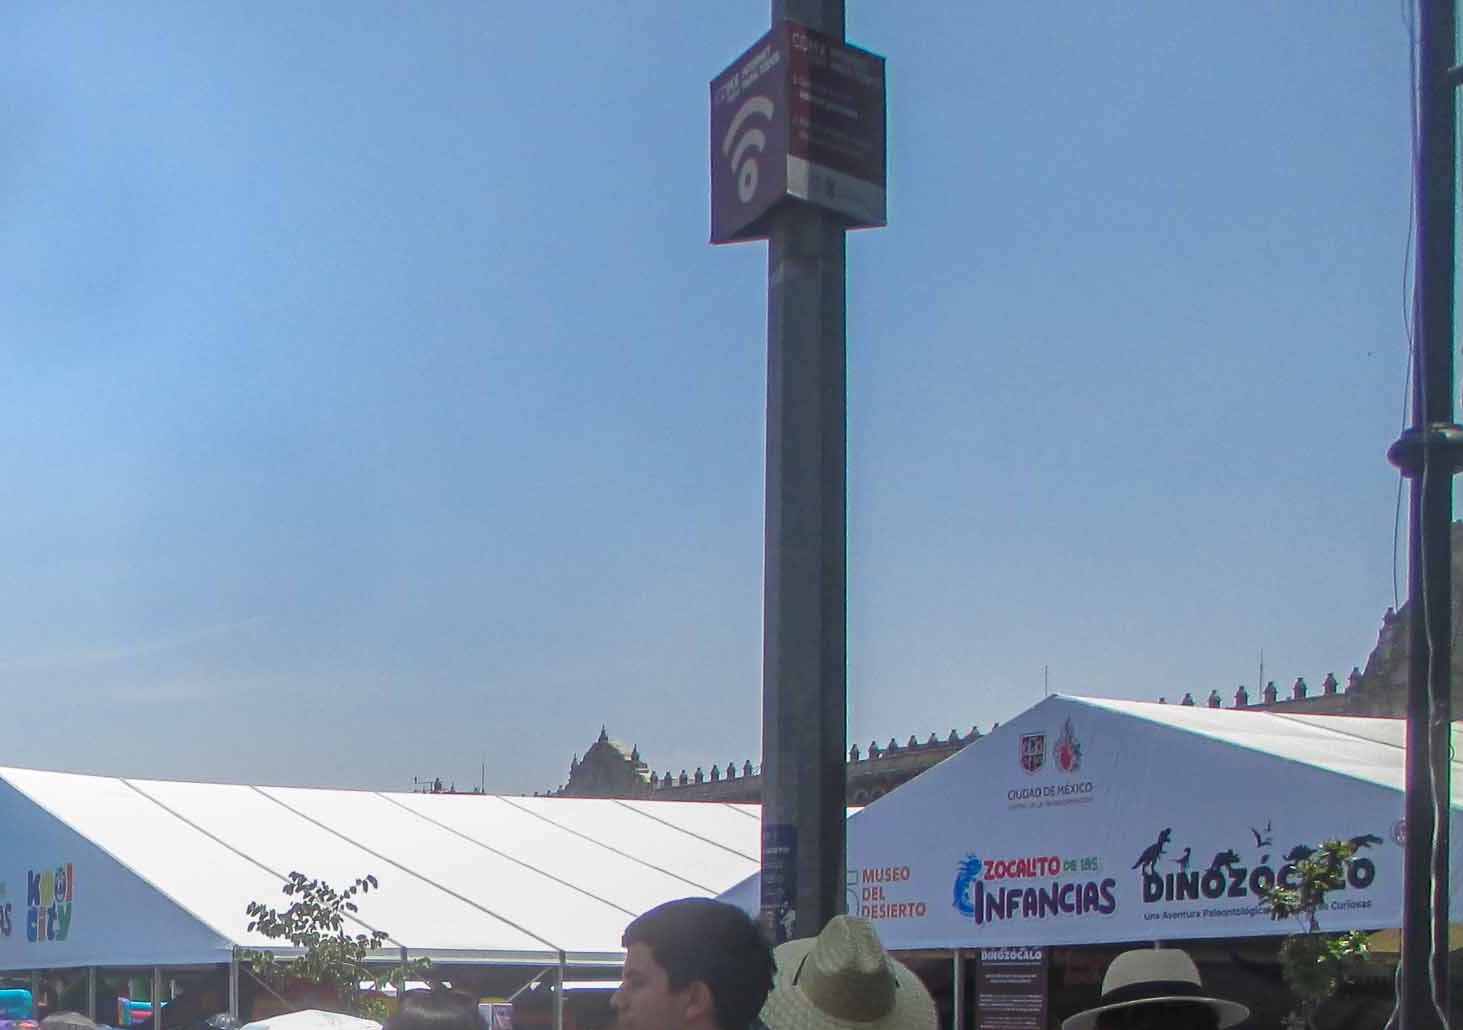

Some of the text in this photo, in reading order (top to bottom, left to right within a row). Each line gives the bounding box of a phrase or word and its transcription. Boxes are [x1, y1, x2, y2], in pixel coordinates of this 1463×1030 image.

[862, 865, 911, 883] MUSEO
[982, 855, 1061, 881] ZOCALITO
[862, 886, 886, 901] DEL
[974, 877, 1117, 926] INFANCIAS
[861, 902, 927, 919] DESIERTO
